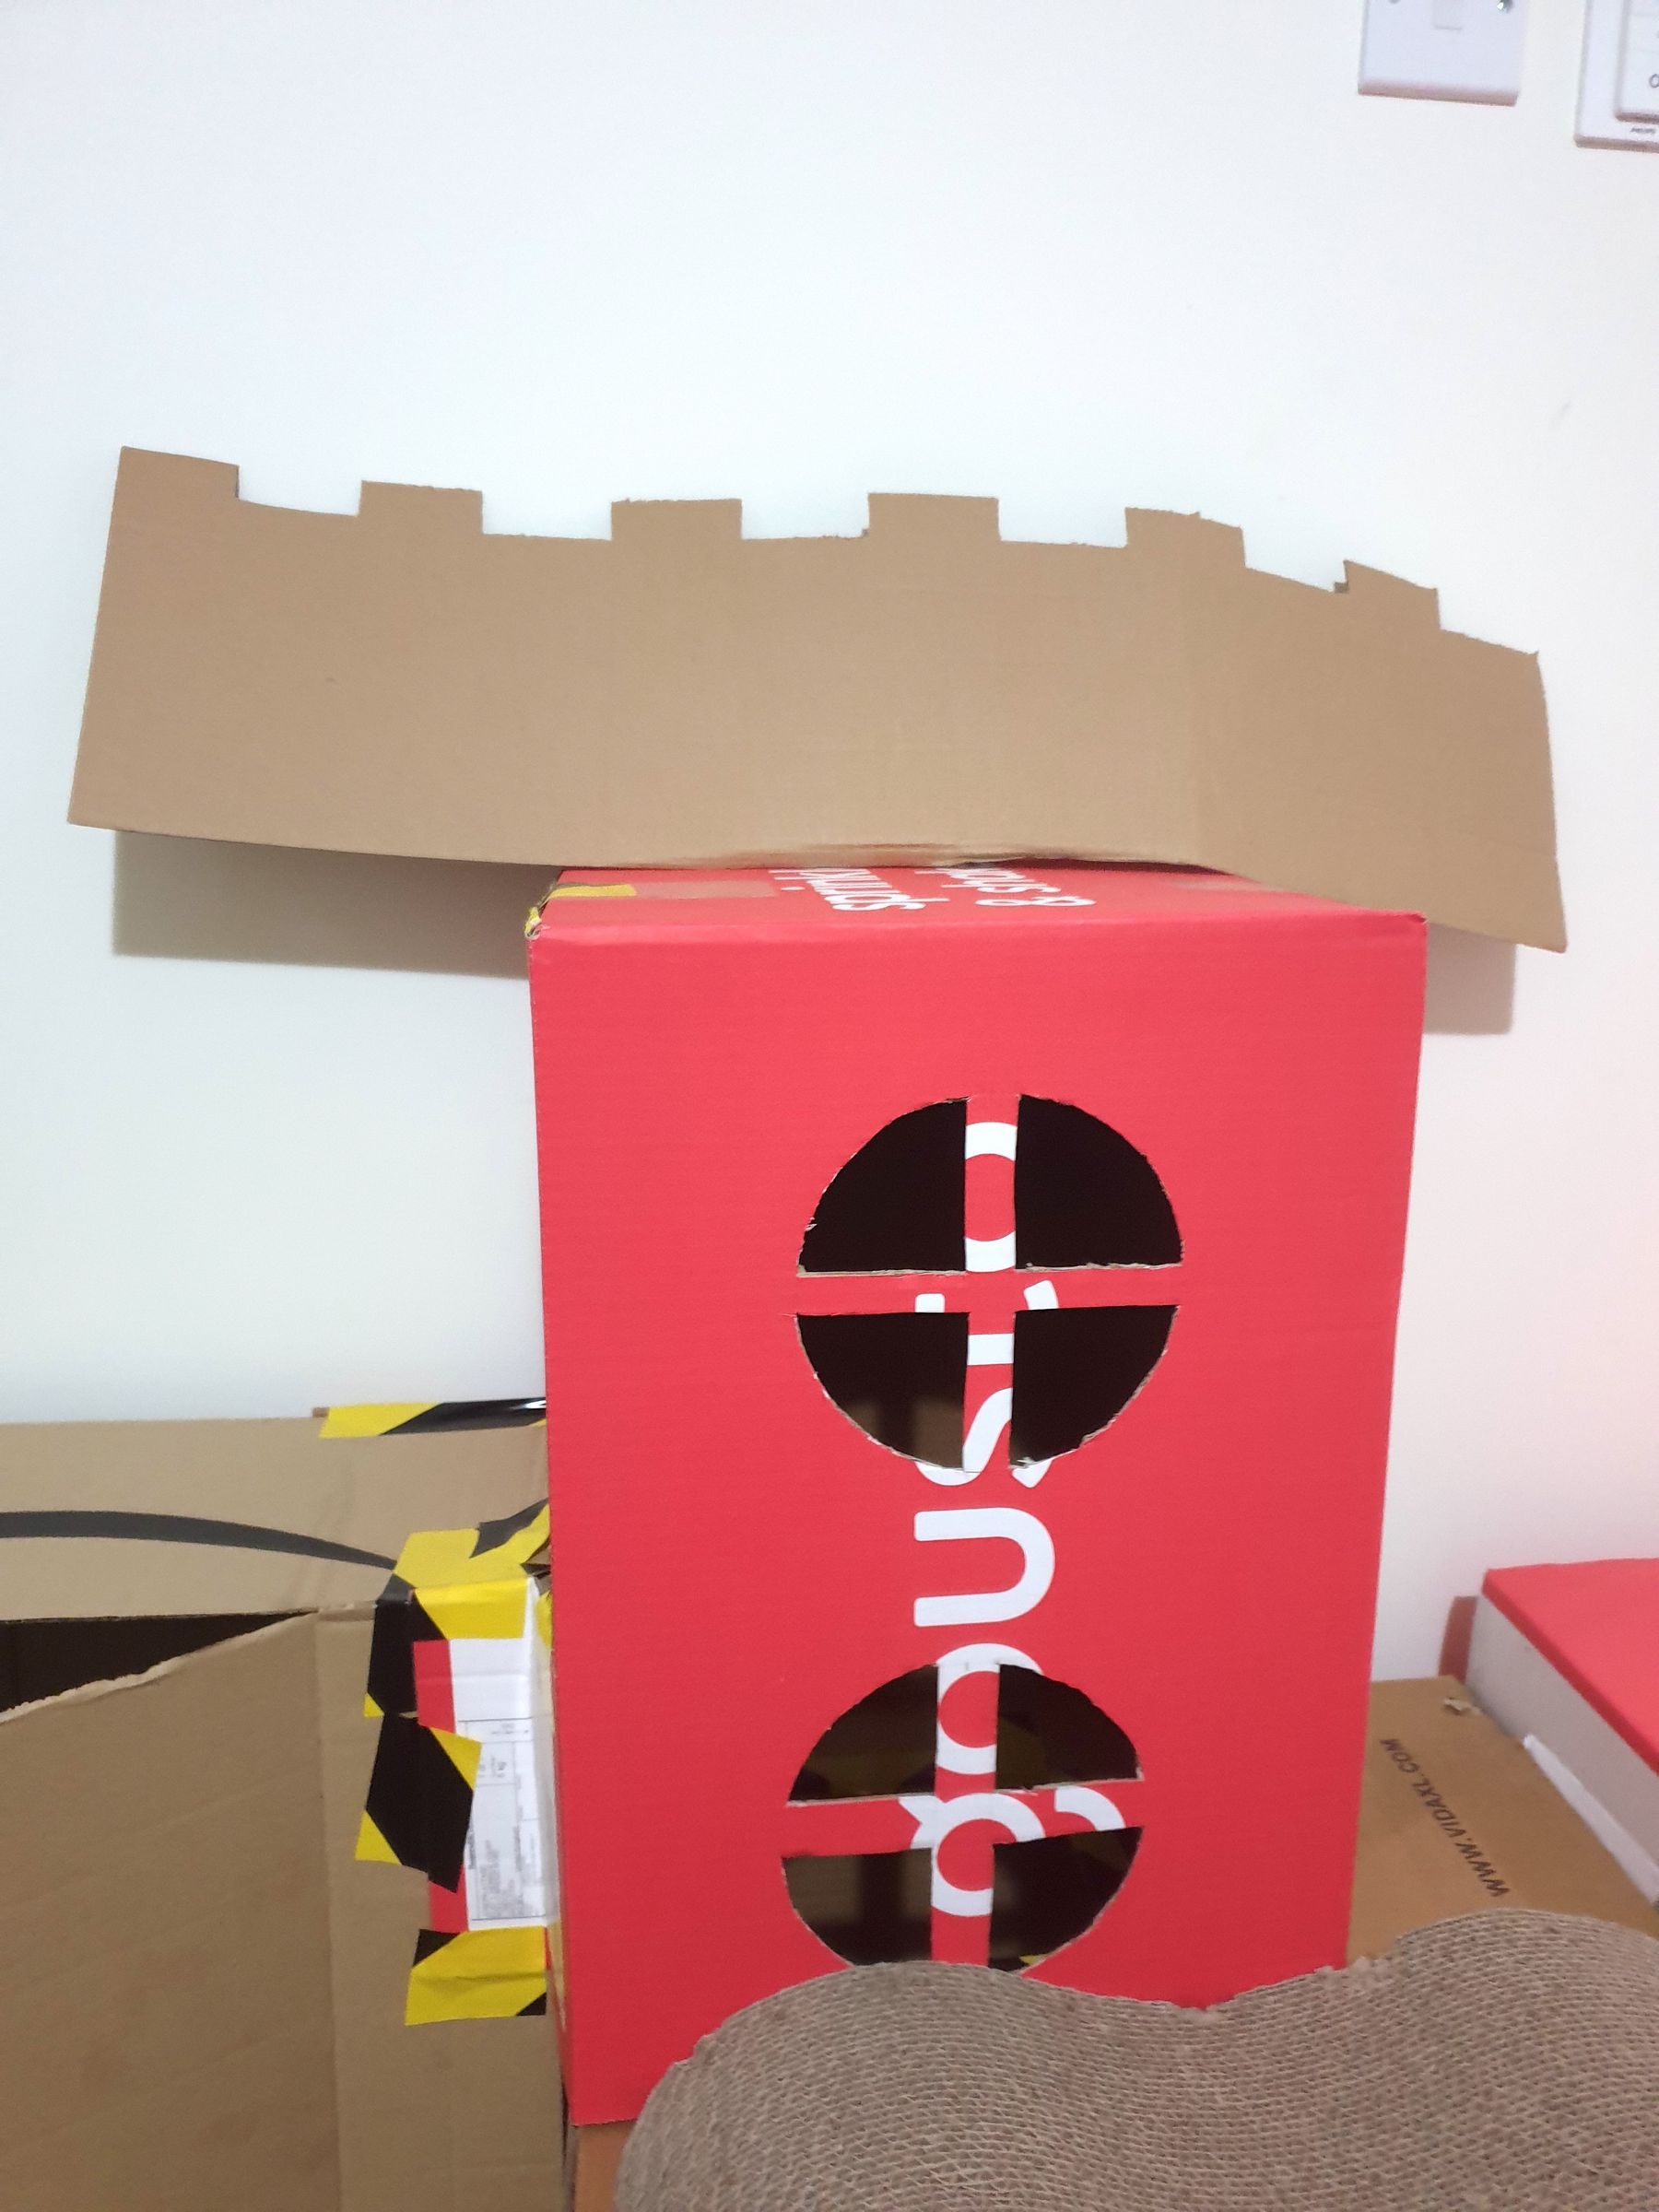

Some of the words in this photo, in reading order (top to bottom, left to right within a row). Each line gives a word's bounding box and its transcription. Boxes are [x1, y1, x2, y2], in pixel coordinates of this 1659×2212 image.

[769, 868, 950, 911] sprinkl
[974, 895, 1097, 907] &
[1380, 1738, 1512, 1897] WWW.VIDAXL.COM
